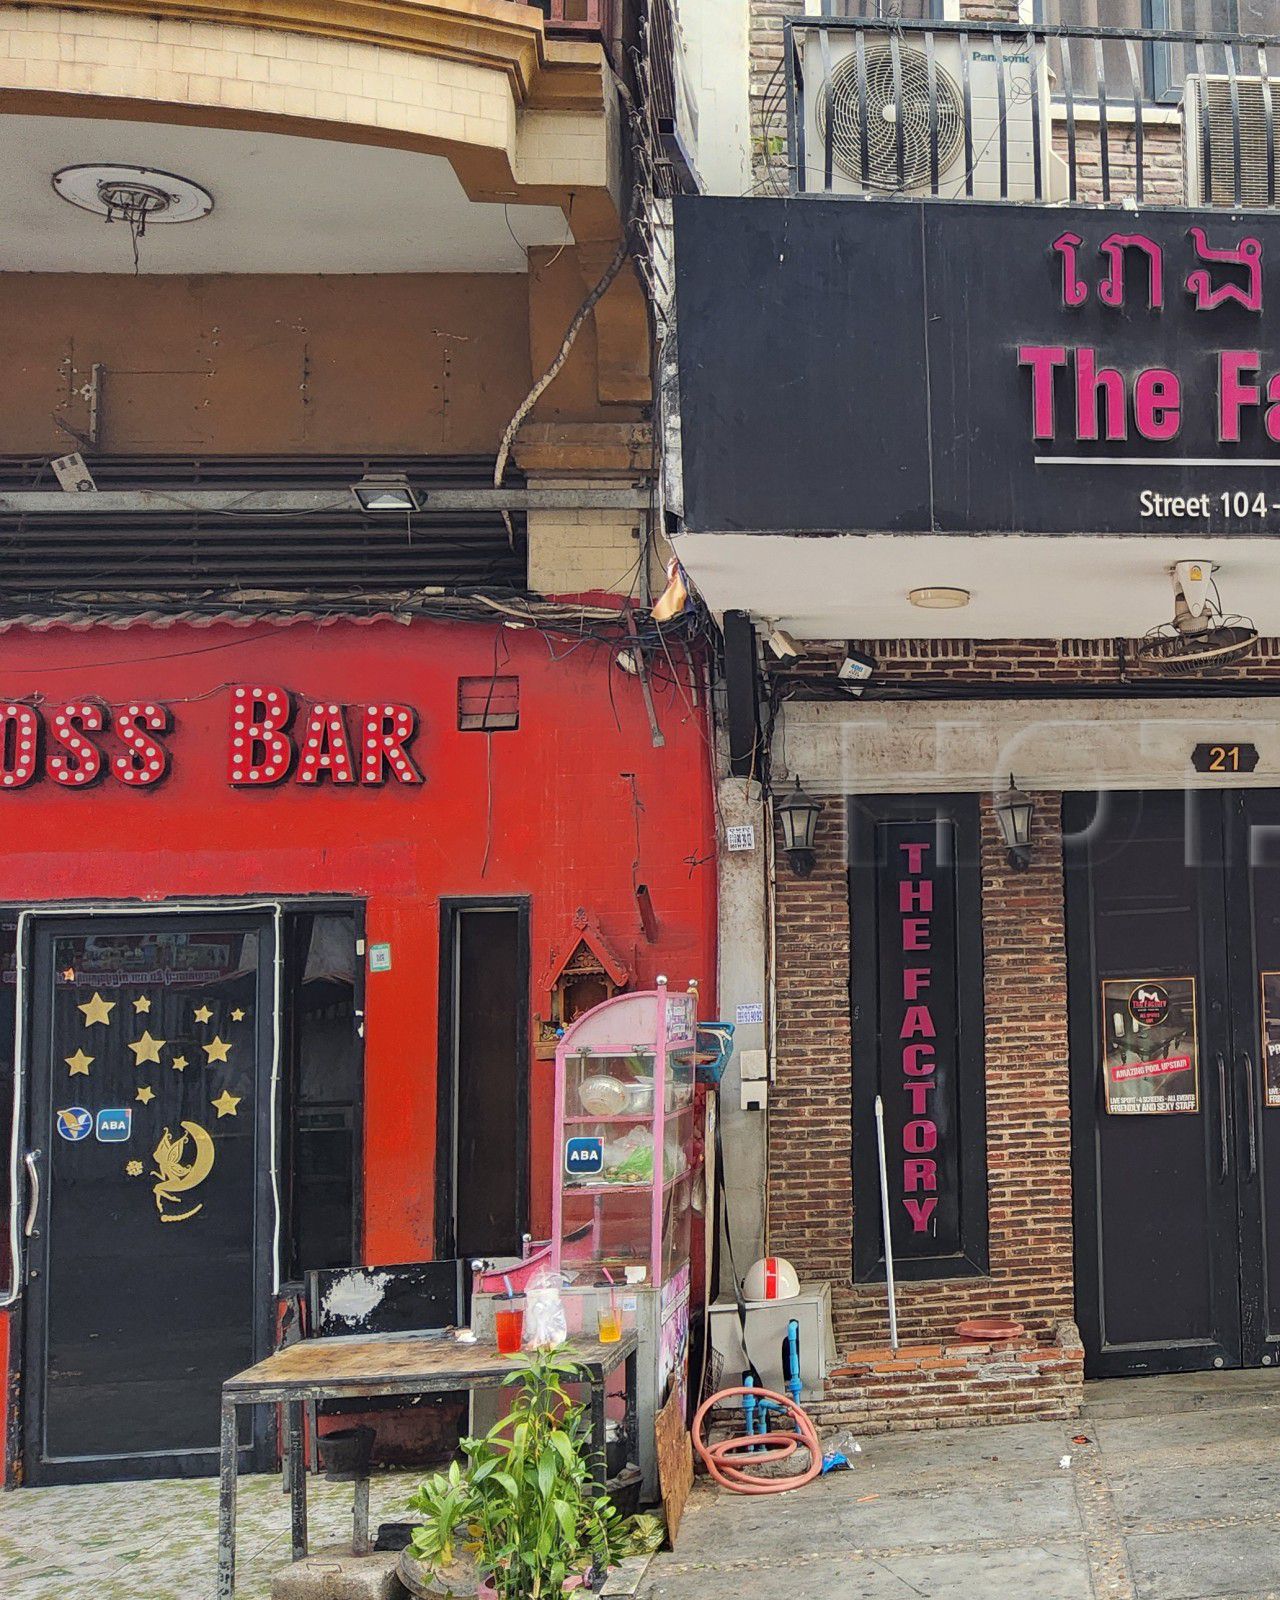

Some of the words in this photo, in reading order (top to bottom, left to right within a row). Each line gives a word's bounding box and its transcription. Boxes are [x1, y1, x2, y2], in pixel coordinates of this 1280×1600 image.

[973, 51, 1029, 63] Pansonic
[1017, 345, 1181, 441] The
[1139, 490, 1210, 517] Street
[1220, 491, 1267, 517] 104
[228, 683, 424, 787] BAR
[1209, 746, 1239, 771] 21
[899, 843, 933, 951] THE
[1116, 1067, 1145, 1079] AMAZING
[899, 967, 939, 1233] FACTORY
[1110, 1104, 1141, 1112] FRIENDLY
[1141, 1103, 1156, 1111] AND
[1157, 1102, 1176, 1111] SEXY
[1176, 1101, 1195, 1110] STAFF
[101, 1120, 126, 1131] ABA
[570, 1150, 598, 1161] ABA
